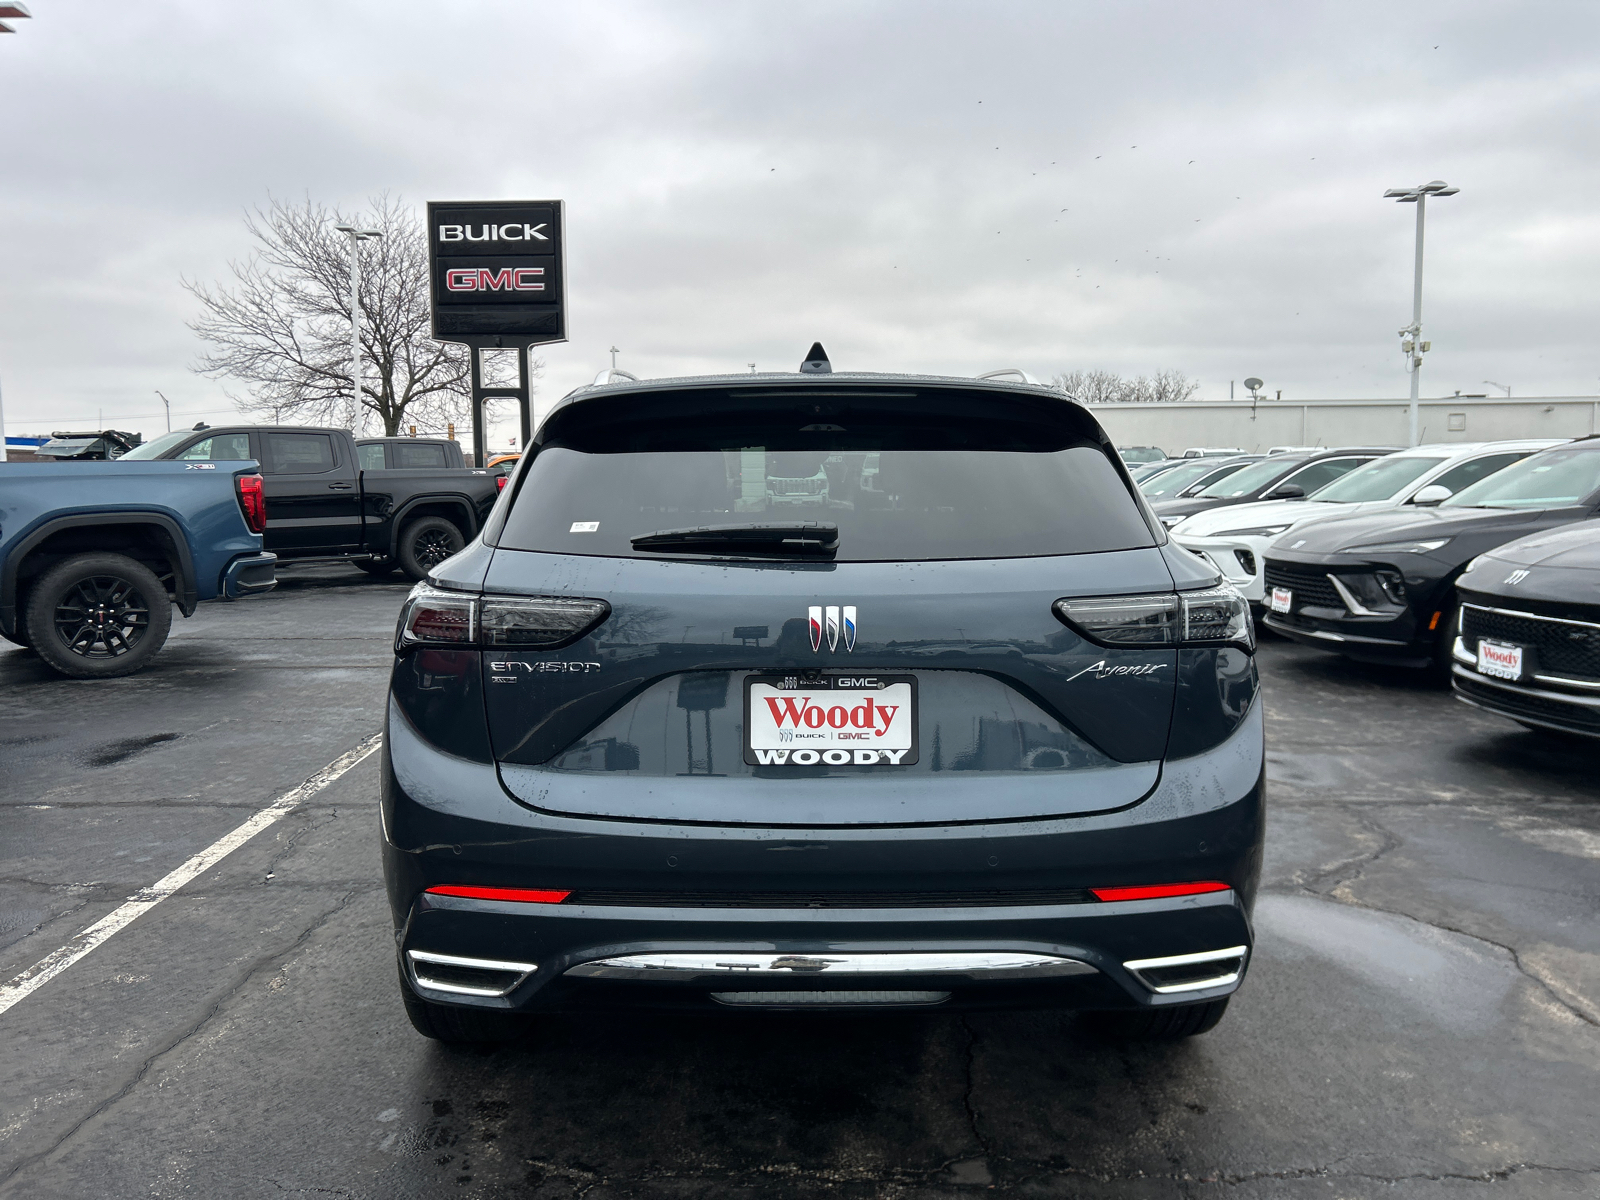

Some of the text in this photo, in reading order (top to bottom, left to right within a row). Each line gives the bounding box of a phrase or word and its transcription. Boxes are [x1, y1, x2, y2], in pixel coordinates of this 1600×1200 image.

[440, 223, 549, 242] BUICK
[446, 267, 545, 292] GMC
[1483, 645, 1520, 669] Woody
[1066, 660, 1168, 682] Avenir
[838, 677, 878, 687] GMC
[764, 697, 900, 737] Woody
[838, 732, 870, 740] GMC
[754, 749, 909, 765] WOODY
